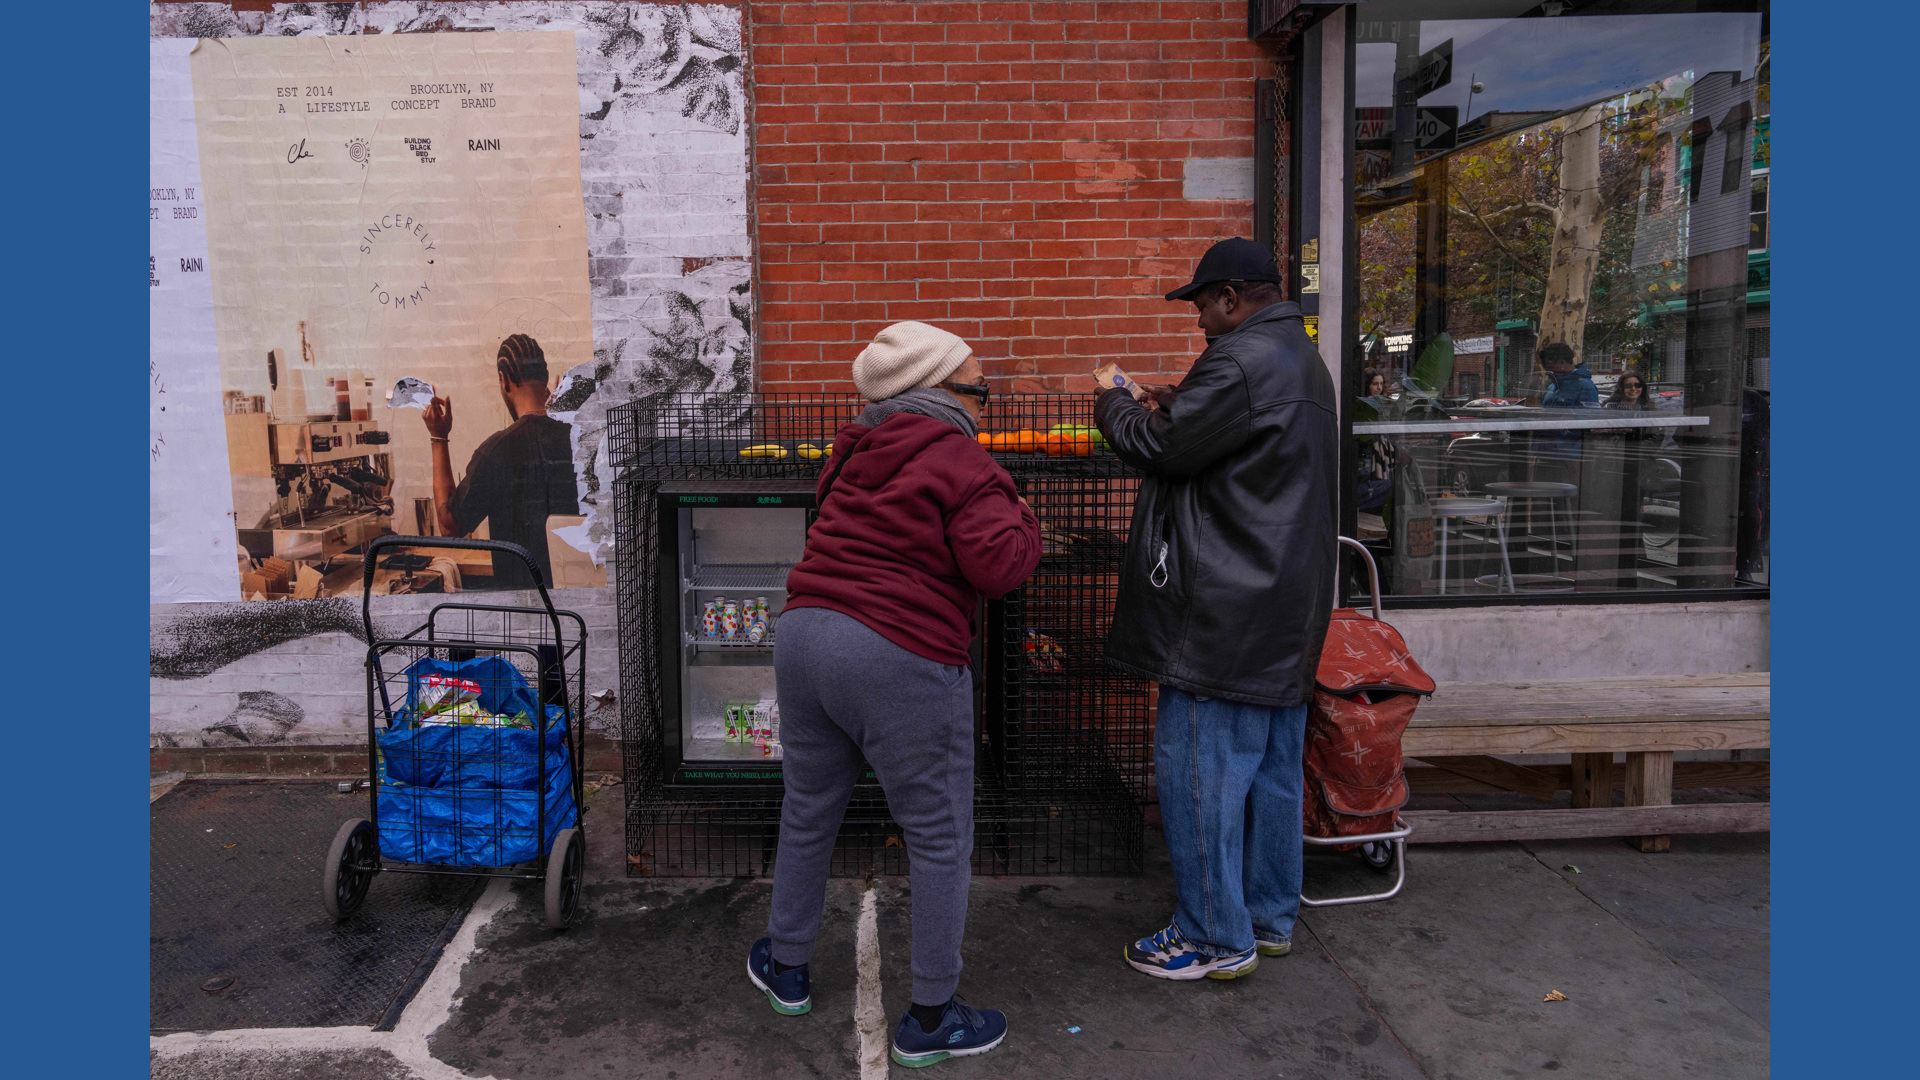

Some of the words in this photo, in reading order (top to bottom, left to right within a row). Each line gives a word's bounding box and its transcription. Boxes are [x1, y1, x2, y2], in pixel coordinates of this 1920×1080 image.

[277, 87, 298, 97] EST
[305, 86, 333, 96] 2014
[410, 83, 471, 95] BROOKLYN,
[480, 82, 494, 93] NY
[278, 103, 286, 113] A
[307, 101, 371, 113] LIFESTYLE
[391, 99, 440, 110] CONCEPT
[461, 98, 496, 109] BRAND
[404, 137, 432, 145] BUILDING
[468, 138, 500, 151] RAINI
[185, 188, 195, 200] NY
[173, 207, 198, 219] BRAND
[180, 257, 204, 272] RAINI
[370, 281, 431, 309] TOMMY
[1384, 334, 1413, 346] TOMPKINS
